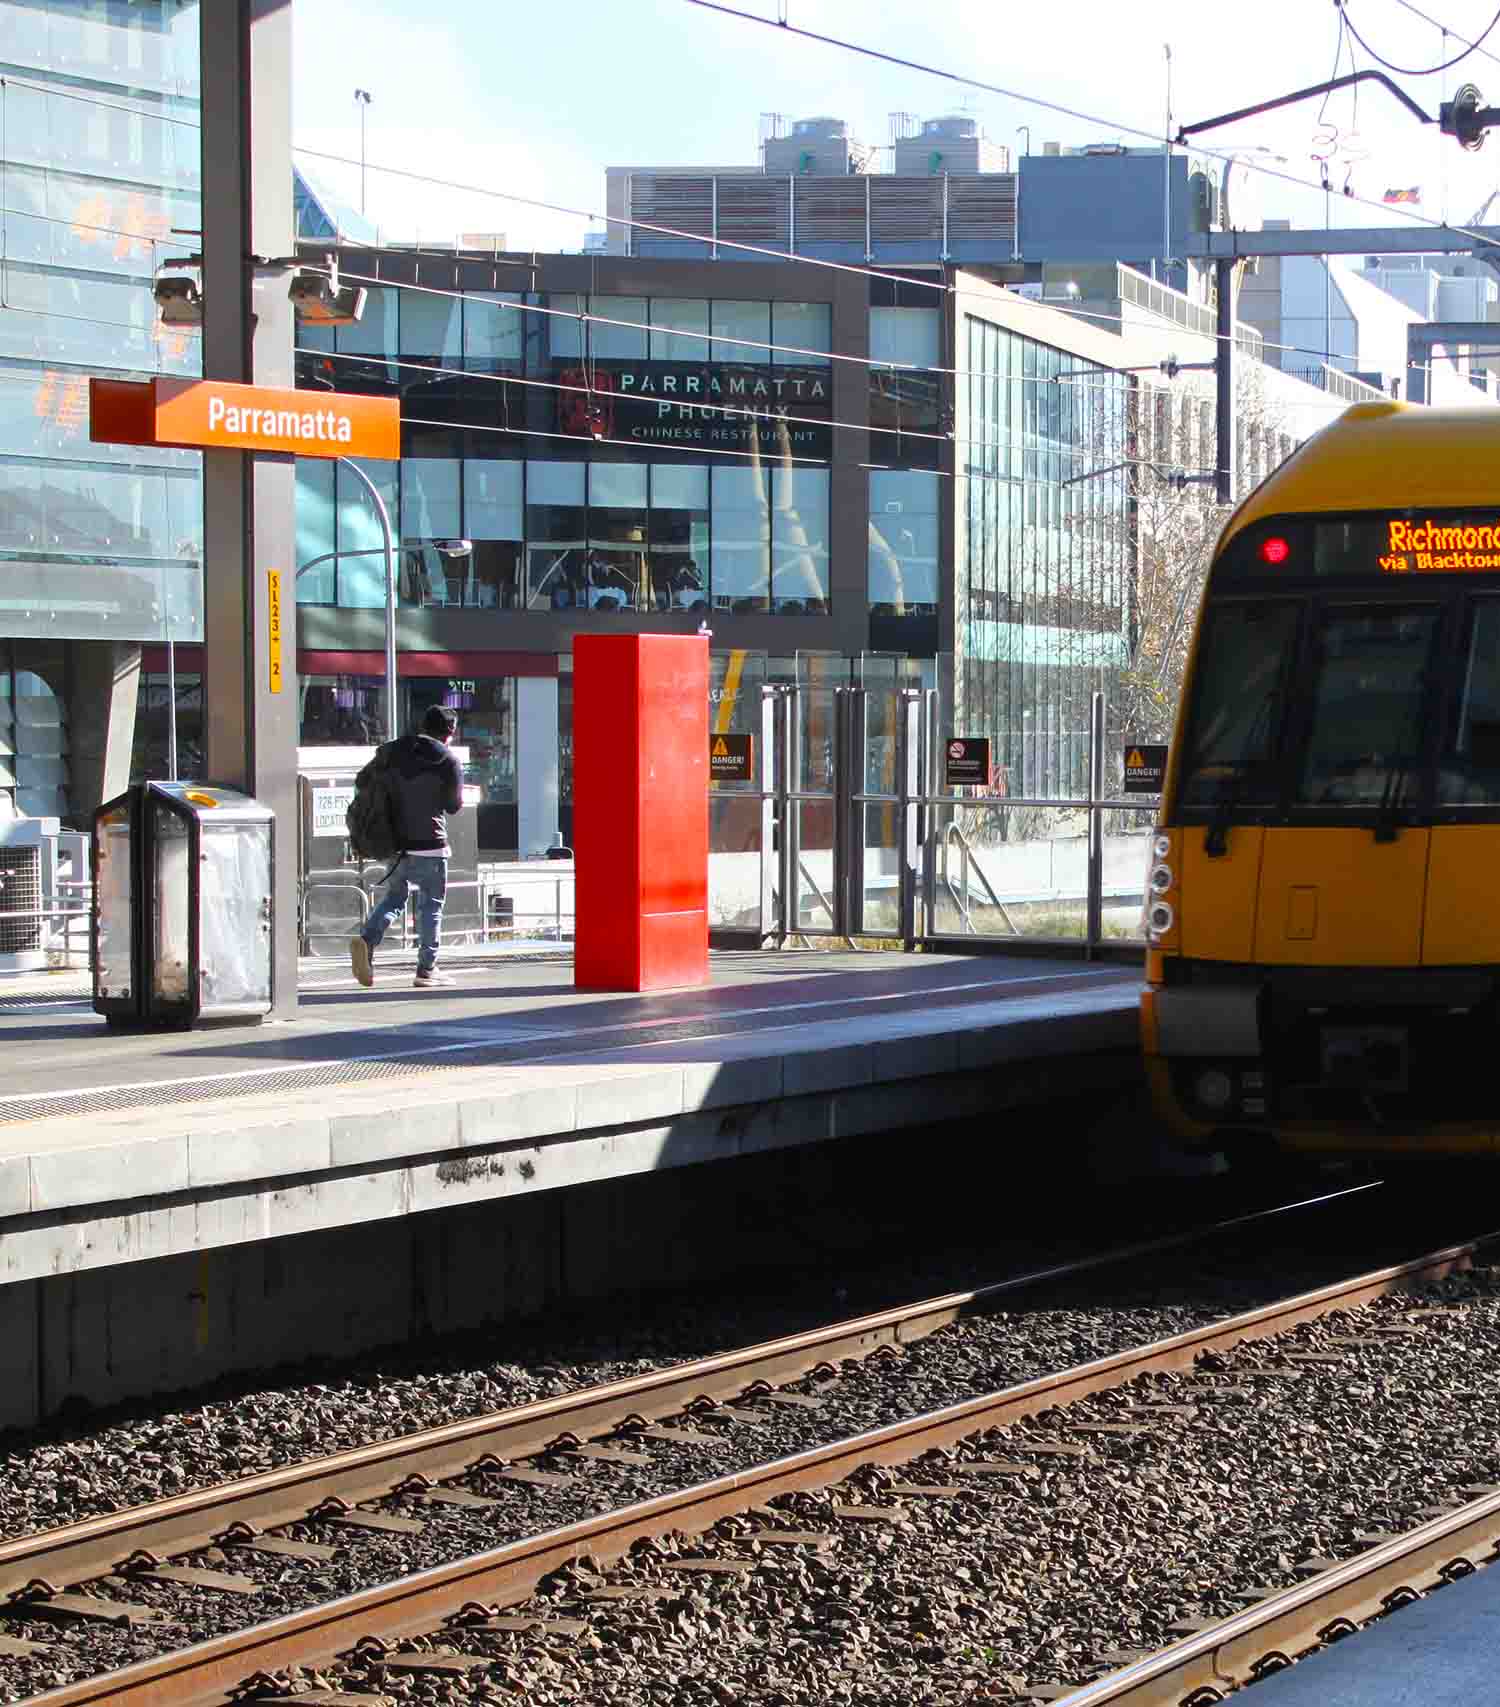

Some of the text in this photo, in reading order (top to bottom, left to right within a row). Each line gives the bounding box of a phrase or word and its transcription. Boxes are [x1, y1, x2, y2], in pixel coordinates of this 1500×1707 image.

[620, 375, 825, 396] PARRAMATTA
[208, 397, 352, 442] Parramatta
[657, 401, 791, 423] PHOENIX
[631, 426, 817, 441] CHINESE RESTAURANT
[1379, 554, 1409, 570] via
[712, 756, 745, 764] DANGER!
